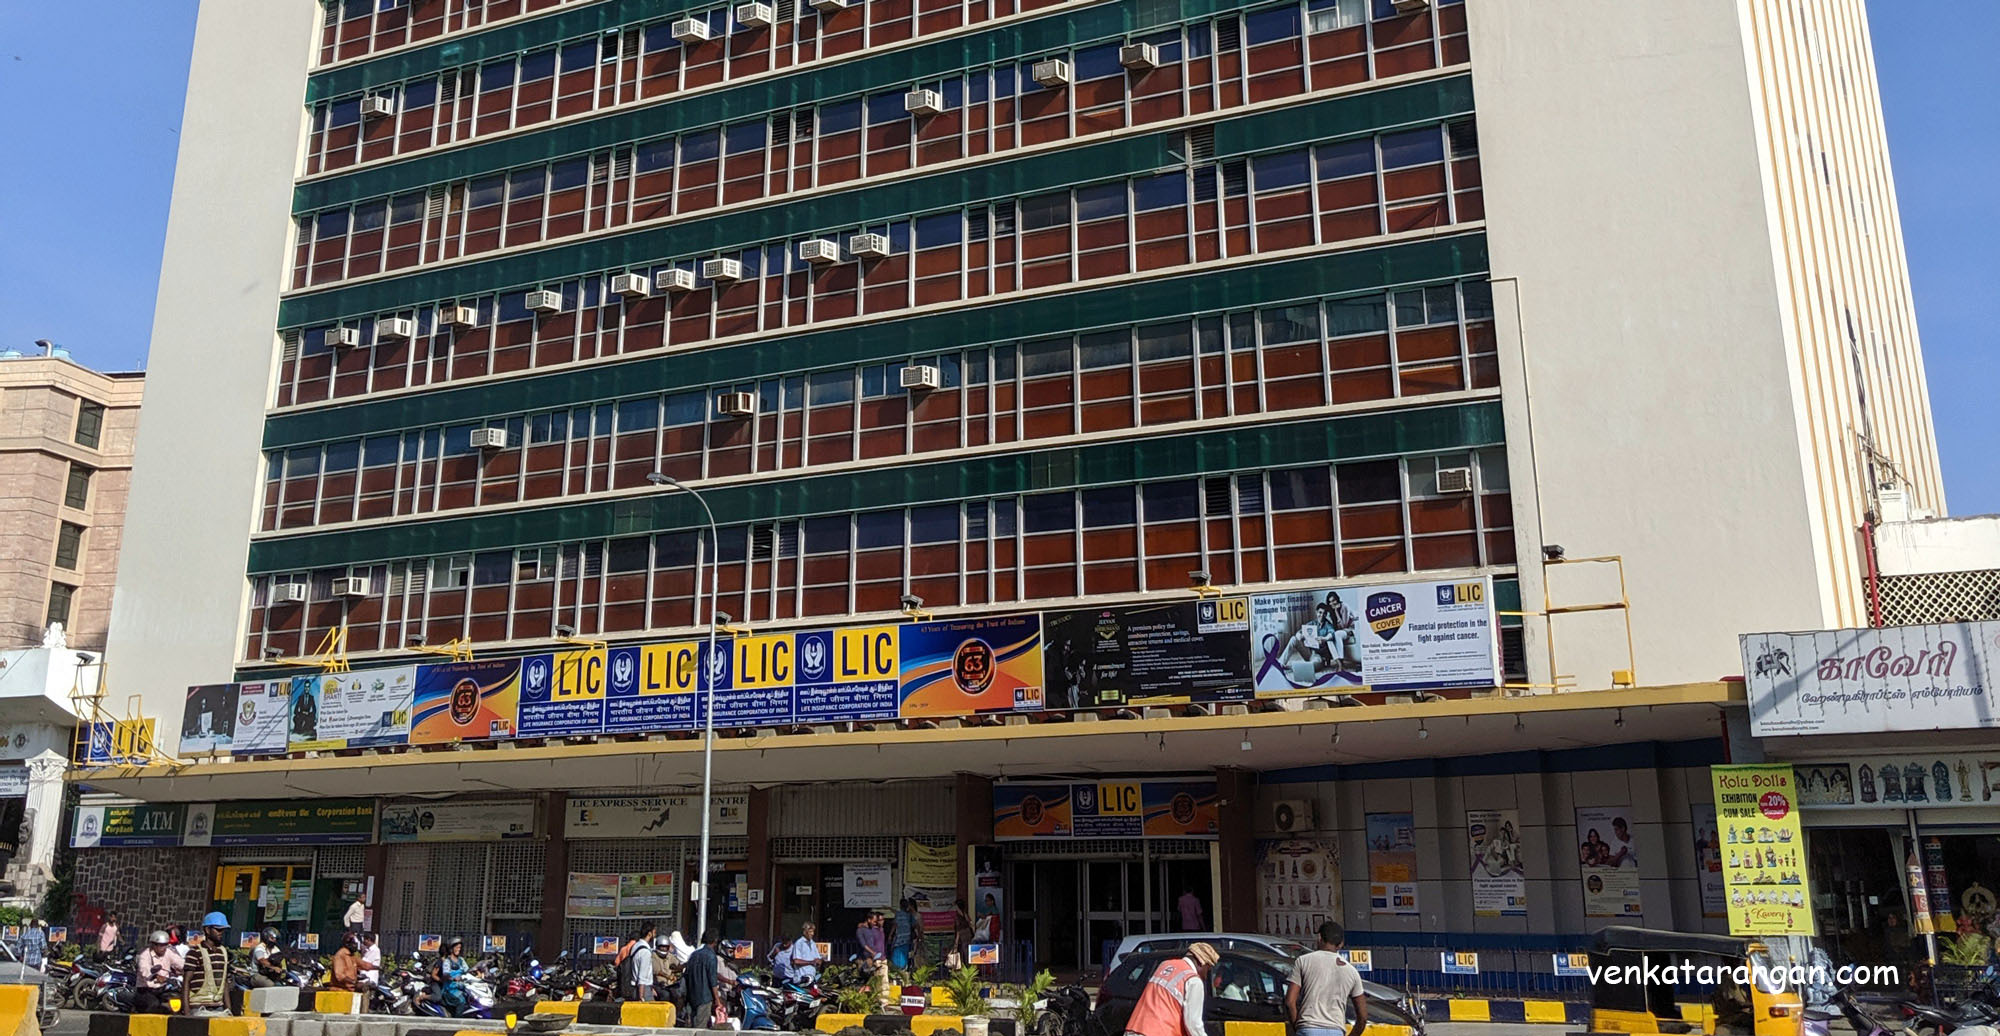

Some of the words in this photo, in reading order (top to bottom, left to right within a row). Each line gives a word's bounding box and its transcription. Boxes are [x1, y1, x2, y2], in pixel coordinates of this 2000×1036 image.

[1458, 585, 1480, 602] LIC
[1220, 602, 1244, 620] LIC
[1370, 603, 1402, 617] CANCER
[1376, 618, 1400, 630] COVER
[1408, 623, 1435, 631] Financial
[1438, 621, 1468, 631] protection
[1418, 634, 1432, 643] fight
[1434, 633, 1455, 643] against
[1457, 632, 1479, 640] cancer.
[842, 633, 892, 676] LIC
[1818, 640, 1957, 681] காவேரி
[741, 641, 788, 683] LIC
[964, 655, 983, 671] 63
[647, 649, 691, 689] LIC
[559, 656, 601, 696] LIC
[1026, 689, 1040, 700] LIC
[1912, 684, 1983, 700] எம்போரியம்
[393, 711, 406, 724] LIC
[498, 720, 509, 731] LIC
[1720, 775, 1748, 789] Kolu
[1752, 774, 1787, 787] Dolls
[593, 799, 639, 807] EXPRESS
[641, 798, 687, 807] SERVICE
[710, 796, 746, 805] ENTRE
[1102, 786, 1136, 812] LIC
[1722, 793, 1757, 804] EXHIBITION
[1768, 795, 1786, 806] 20%
[316, 807, 355, 818] Corporation
[357, 806, 372, 815] Bank
[1723, 808, 1738, 818] CUM
[1740, 807, 1756, 817] SALE
[140, 811, 175, 831] ATM
[494, 937, 504, 945] LIC
[1351, 952, 1367, 962] LIC
[1458, 953, 1474, 965] LIC
[1572, 954, 1588, 966] LIC
